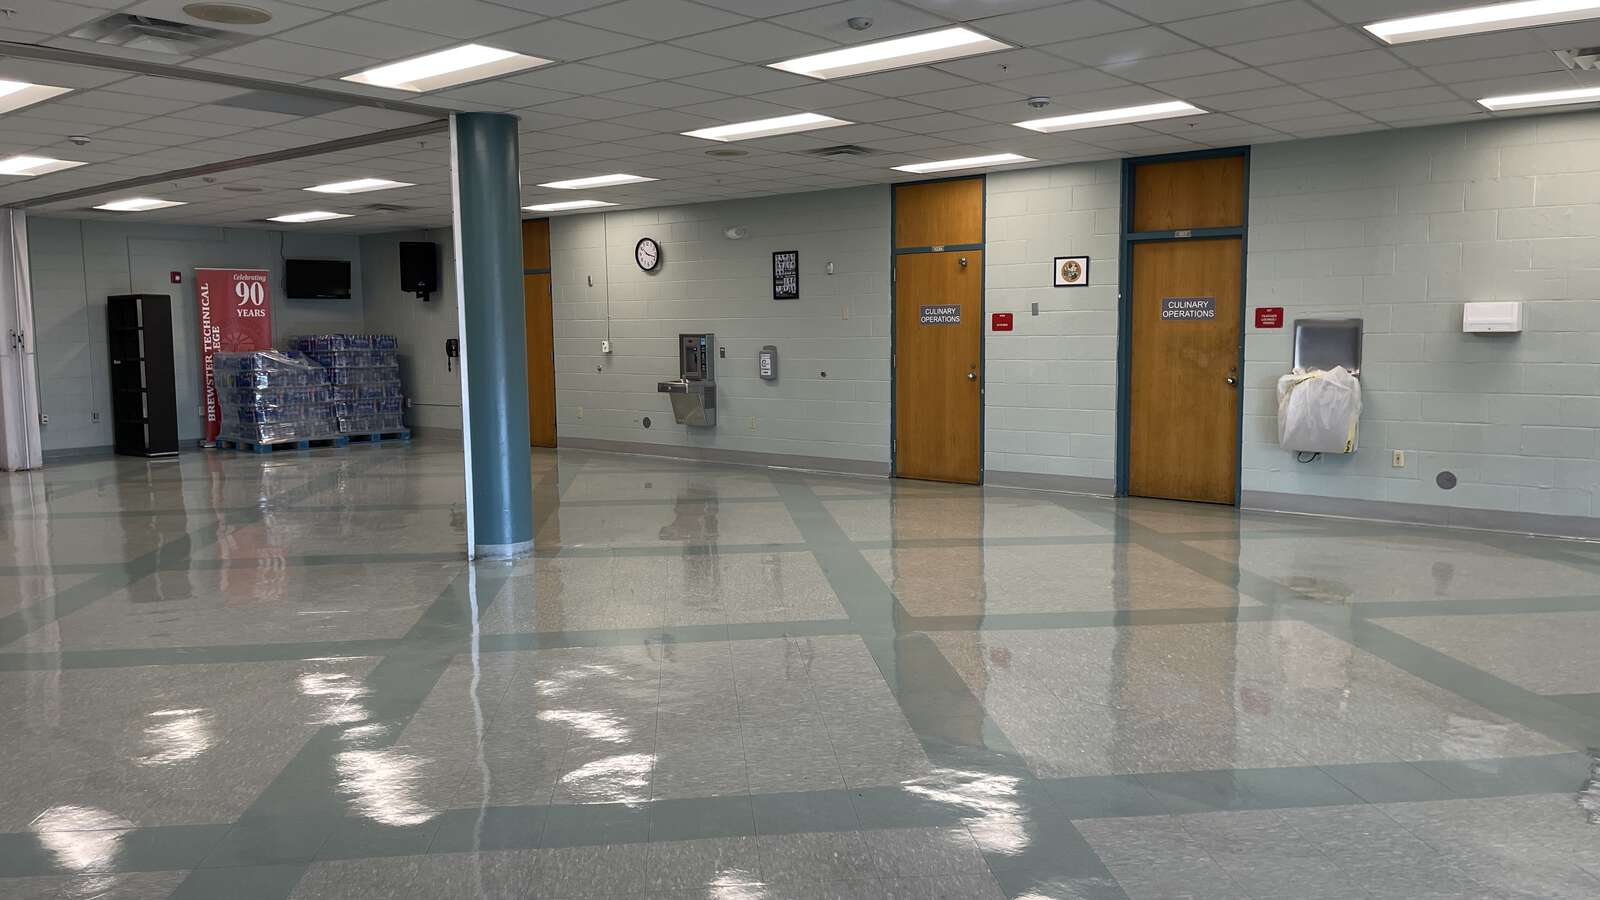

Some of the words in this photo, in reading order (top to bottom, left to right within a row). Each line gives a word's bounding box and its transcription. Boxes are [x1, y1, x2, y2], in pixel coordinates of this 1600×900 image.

[235, 281, 264, 306] 90
[237, 309, 266, 317] YEARS
[1168, 301, 1208, 309] CULINARY
[201, 283, 212, 352] TECHNICAL
[1162, 310, 1215, 318] OPERATIONS
[205, 355, 216, 422] BREWSTER
